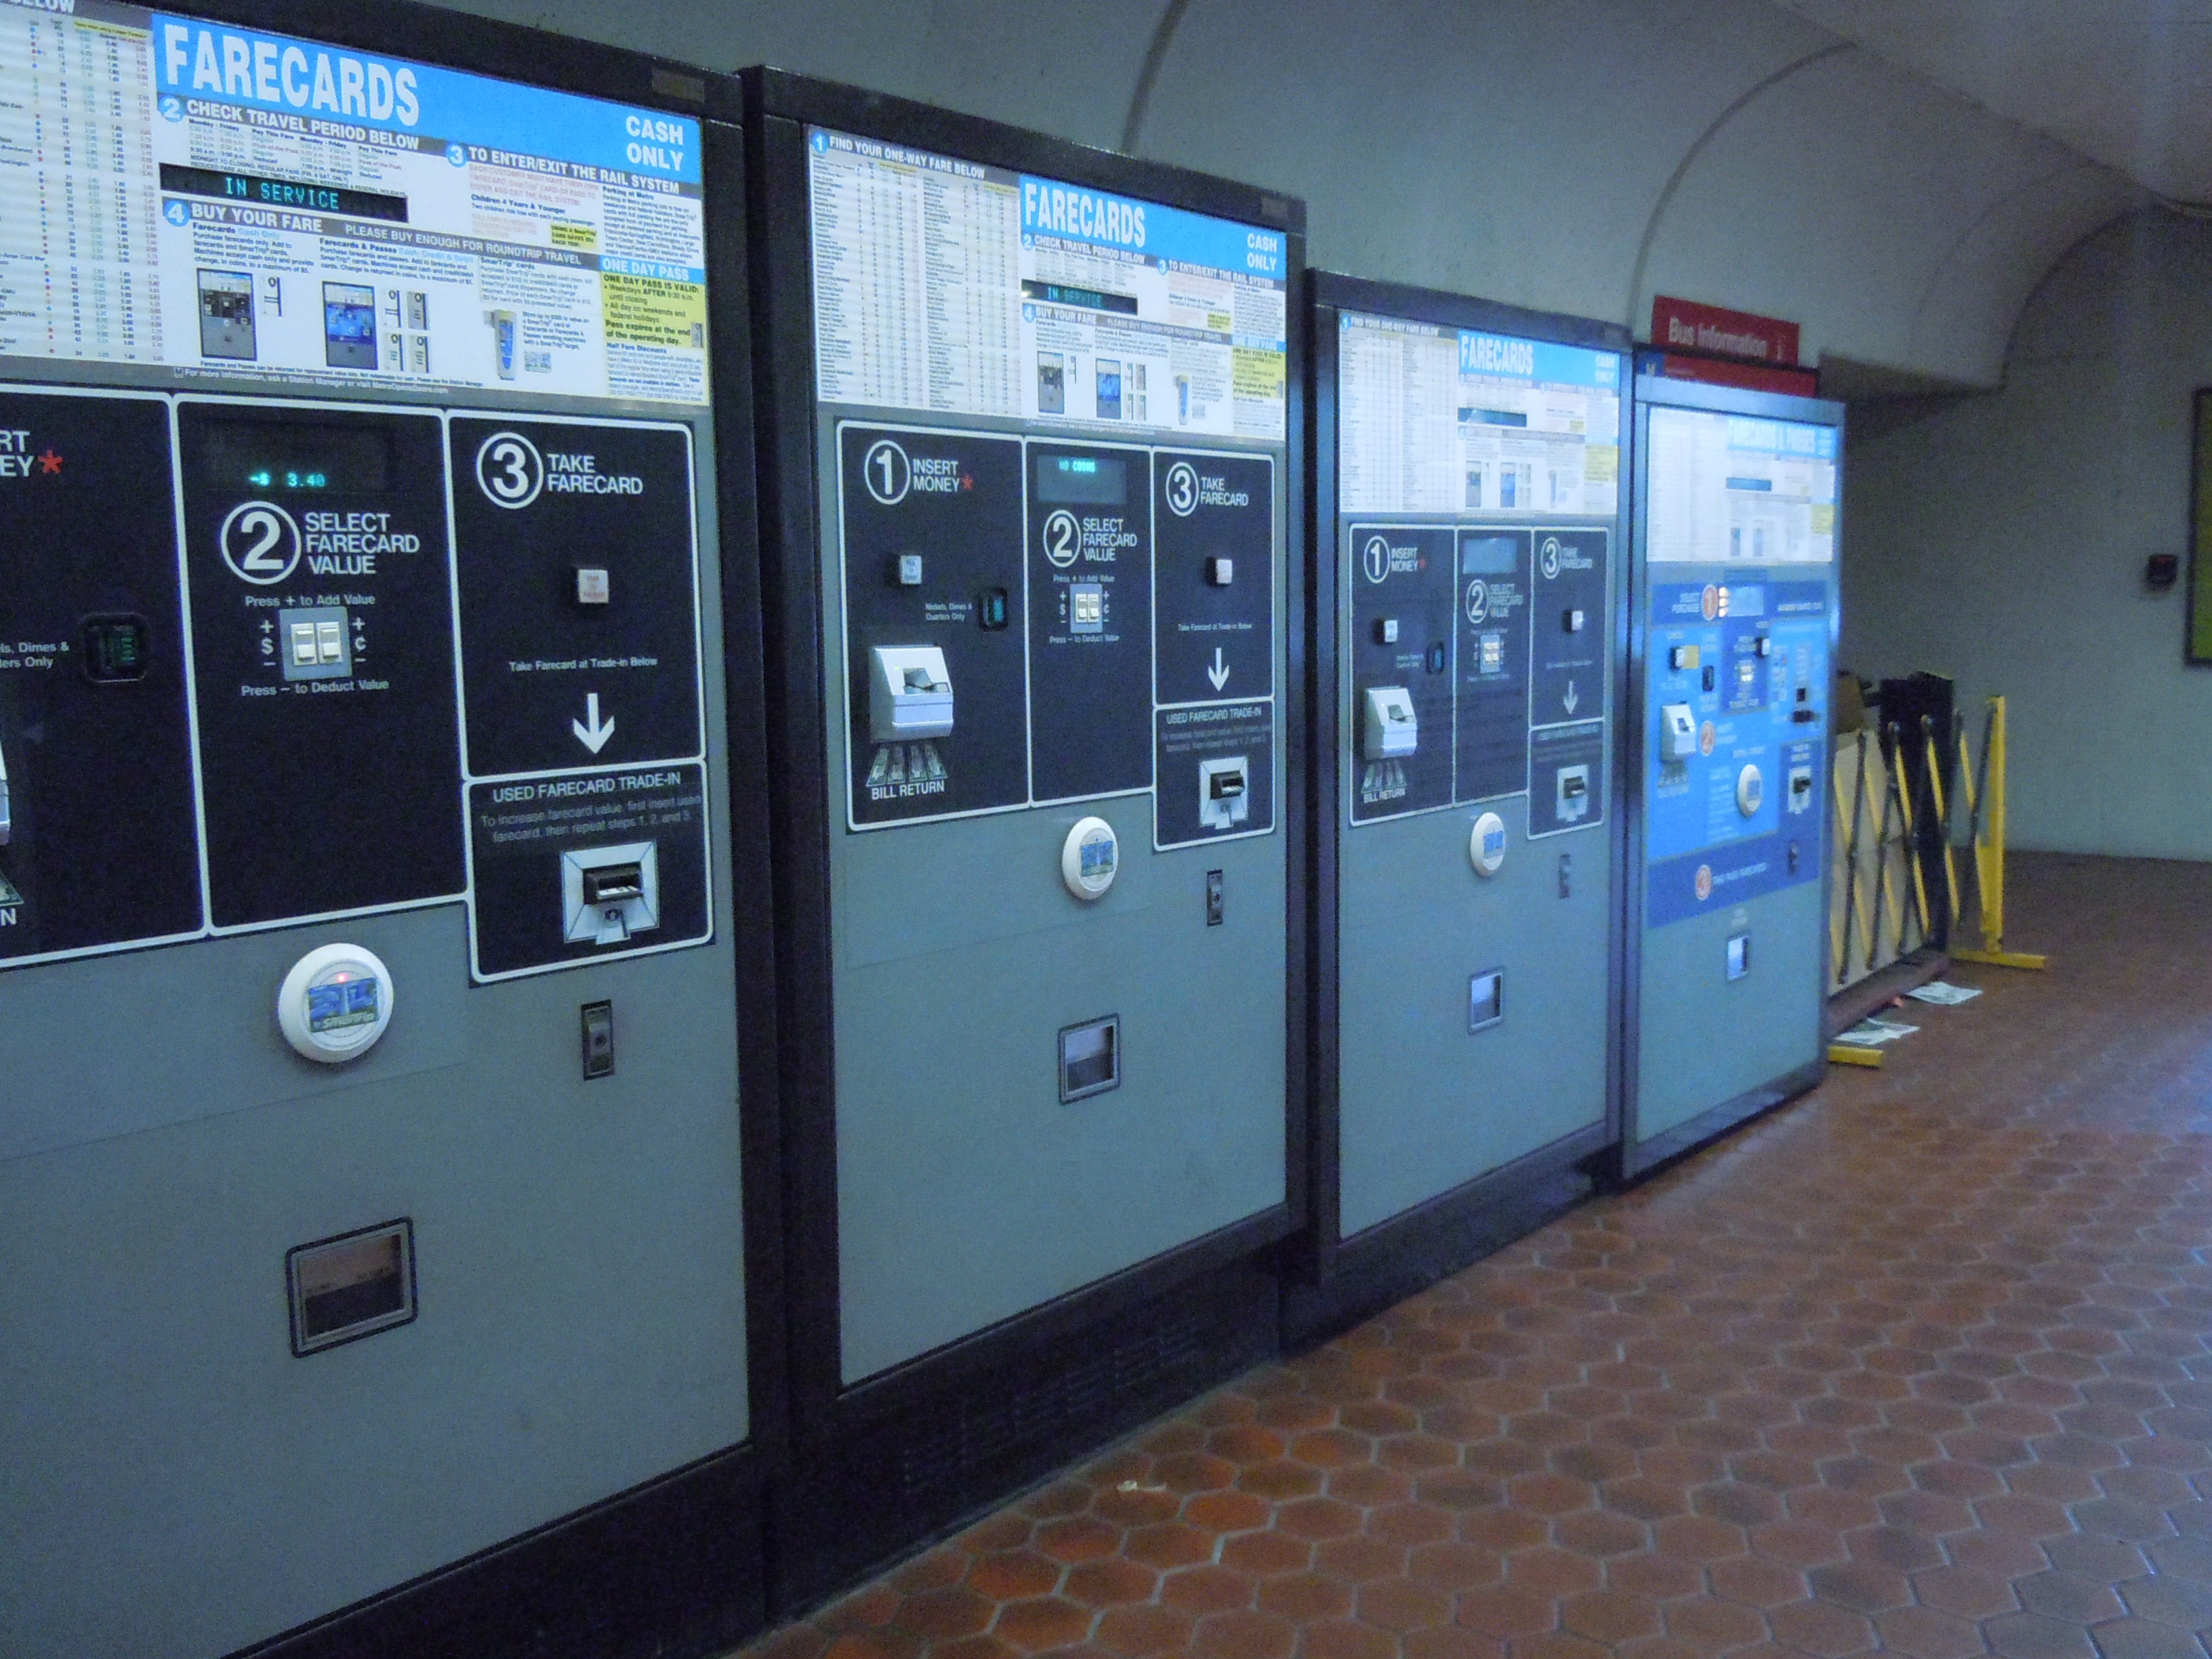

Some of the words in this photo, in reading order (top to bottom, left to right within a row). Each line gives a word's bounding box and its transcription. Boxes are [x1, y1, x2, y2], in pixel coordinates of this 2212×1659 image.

[165, 24, 419, 127] FARECARDS
[164, 98, 180, 119] 2
[187, 100, 243, 121] CHECK
[247, 109, 308, 133] TRAVEL
[311, 119, 366, 142] PERIOD
[369, 129, 419, 150] BELOW
[626, 116, 683, 146] CASH
[627, 142, 683, 171] ONLY
[815, 136, 824, 151] 1
[830, 136, 853, 150] FIND
[855, 141, 882, 158] YOUR
[884, 147, 927, 169] ONE-WAY
[929, 157, 952, 172] FARE
[954, 163, 985, 180] BELOW
[450, 146, 464, 164] 3
[469, 146, 487, 161] TO
[491, 150, 568, 176] ENTER/EXIT
[571, 163, 596, 180] THE
[600, 169, 629, 186] RAIL
[632, 174, 679, 194] SYSTEM
[225, 177, 247, 196] IN
[261, 182, 339, 209] SERVICE
[471, 194, 501, 205] Children
[508, 199, 529, 209] Years
[537, 204, 566, 214] Younger
[168, 203, 185, 223] 4
[192, 203, 226, 221] BUY
[231, 207, 278, 228] YOUR
[281, 214, 323, 233] FARE
[1025, 183, 1145, 247] FARECARDS
[192, 222, 236, 234] Farecards
[345, 224, 388, 239] PLEASE
[391, 230, 413, 242] BUY
[415, 232, 460, 249] ENOUGH
[463, 240, 483, 251] FOR
[486, 242, 541, 259] ROUNDTRIP
[544, 251, 581, 264] TRAVEL
[1023, 234, 1031, 248] 2
[1034, 234, 1061, 249] CHECK
[1063, 240, 1092, 255] TRAVEL
[1093, 245, 1119, 259] PERIOD
[1120, 251, 1145, 265] BELOW
[1247, 233, 1277, 253] CASH
[602, 258, 628, 272] ONE
[632, 261, 655, 276] DAY
[659, 265, 689, 281] PASS
[1247, 252, 1277, 272] ONLY
[603, 274, 621, 283] ONE
[623, 276, 639, 285] DAY
[642, 279, 663, 289] PASS
[1159, 260, 1166, 272] 3
[1168, 260, 1178, 270] TO
[1179, 262, 1217, 279] ENTER/EXIT
[1219, 270, 1232, 281] THE
[1233, 272, 1248, 284] RAIL
[1249, 275, 1273, 289] SYSTEM
[610, 284, 641, 295] Weekdays
[643, 288, 666, 297] AFTER
[625, 295, 649, 305] closing
[620, 304, 632, 312] day
[643, 307, 673, 316] weekends
[1025, 307, 1033, 320] 4
[1036, 306, 1053, 319] BUY
[1054, 308, 1075, 322] YOUR
[1078, 312, 1097, 325] FARE
[605, 320, 623, 329] Pass
[626, 323, 653, 333] expires
[615, 331, 628, 339] the
[630, 333, 665, 344] operating
[666, 337, 681, 346] day.
[1668, 316, 1694, 346] Bus
[1698, 323, 1767, 358] Information
[1461, 335, 1533, 375] FARECARDS
[493, 443, 529, 497] 3
[547, 453, 596, 474] TAKE
[876, 449, 893, 495] 1
[913, 458, 958, 476] INSERT
[1072, 460, 1096, 472] COINS
[547, 474, 643, 495] FARECARD
[913, 475, 960, 493] MONEY
[1173, 470, 1191, 508] 3
[1201, 476, 1225, 491] TAKE
[1200, 491, 1249, 507] FARECARD
[306, 512, 390, 532] SELECT
[1083, 518, 1124, 532] SELECT
[241, 511, 284, 569] 2
[306, 534, 420, 553] FARECARD
[1053, 516, 1072, 557] 2
[1083, 533, 1137, 547] FARECARD
[1083, 548, 1116, 562] VALUE
[1370, 543, 1380, 576] 1
[1391, 548, 1418, 560] INSERT
[1546, 544, 1557, 573] 3
[308, 555, 376, 575] VALUE
[1391, 560, 1418, 573] MONEY
[245, 596, 281, 607] Press
[300, 595, 313, 605] to
[316, 594, 340, 605] Add
[343, 594, 375, 605] Value
[1472, 585, 1483, 616] 2
[18, 642, 56, 653] Dimes
[60, 642, 70, 652] &
[261, 638, 274, 655] $
[25, 656, 54, 668] Only
[509, 661, 533, 672] Take
[535, 660, 576, 670] Farecard
[578, 659, 589, 668] at
[590, 657, 628, 668] Trade-in
[630, 657, 658, 666] Below
[241, 684, 277, 697] Press
[295, 683, 308, 694] to
[311, 681, 354, 693] Deduct
[359, 679, 390, 691] Value
[1166, 713, 1187, 724] USED
[1189, 710, 1228, 722] FARECARD
[1229, 706, 1262, 718] TRADE-IN
[493, 785, 535, 803] USED
[538, 779, 615, 798] FARECARD
[619, 772, 681, 790] TRADE-IN
[872, 786, 897, 800] BILL
[899, 780, 945, 797] RETURN
[1364, 792, 1378, 804] BILL
[1379, 787, 1406, 801] RETURN
